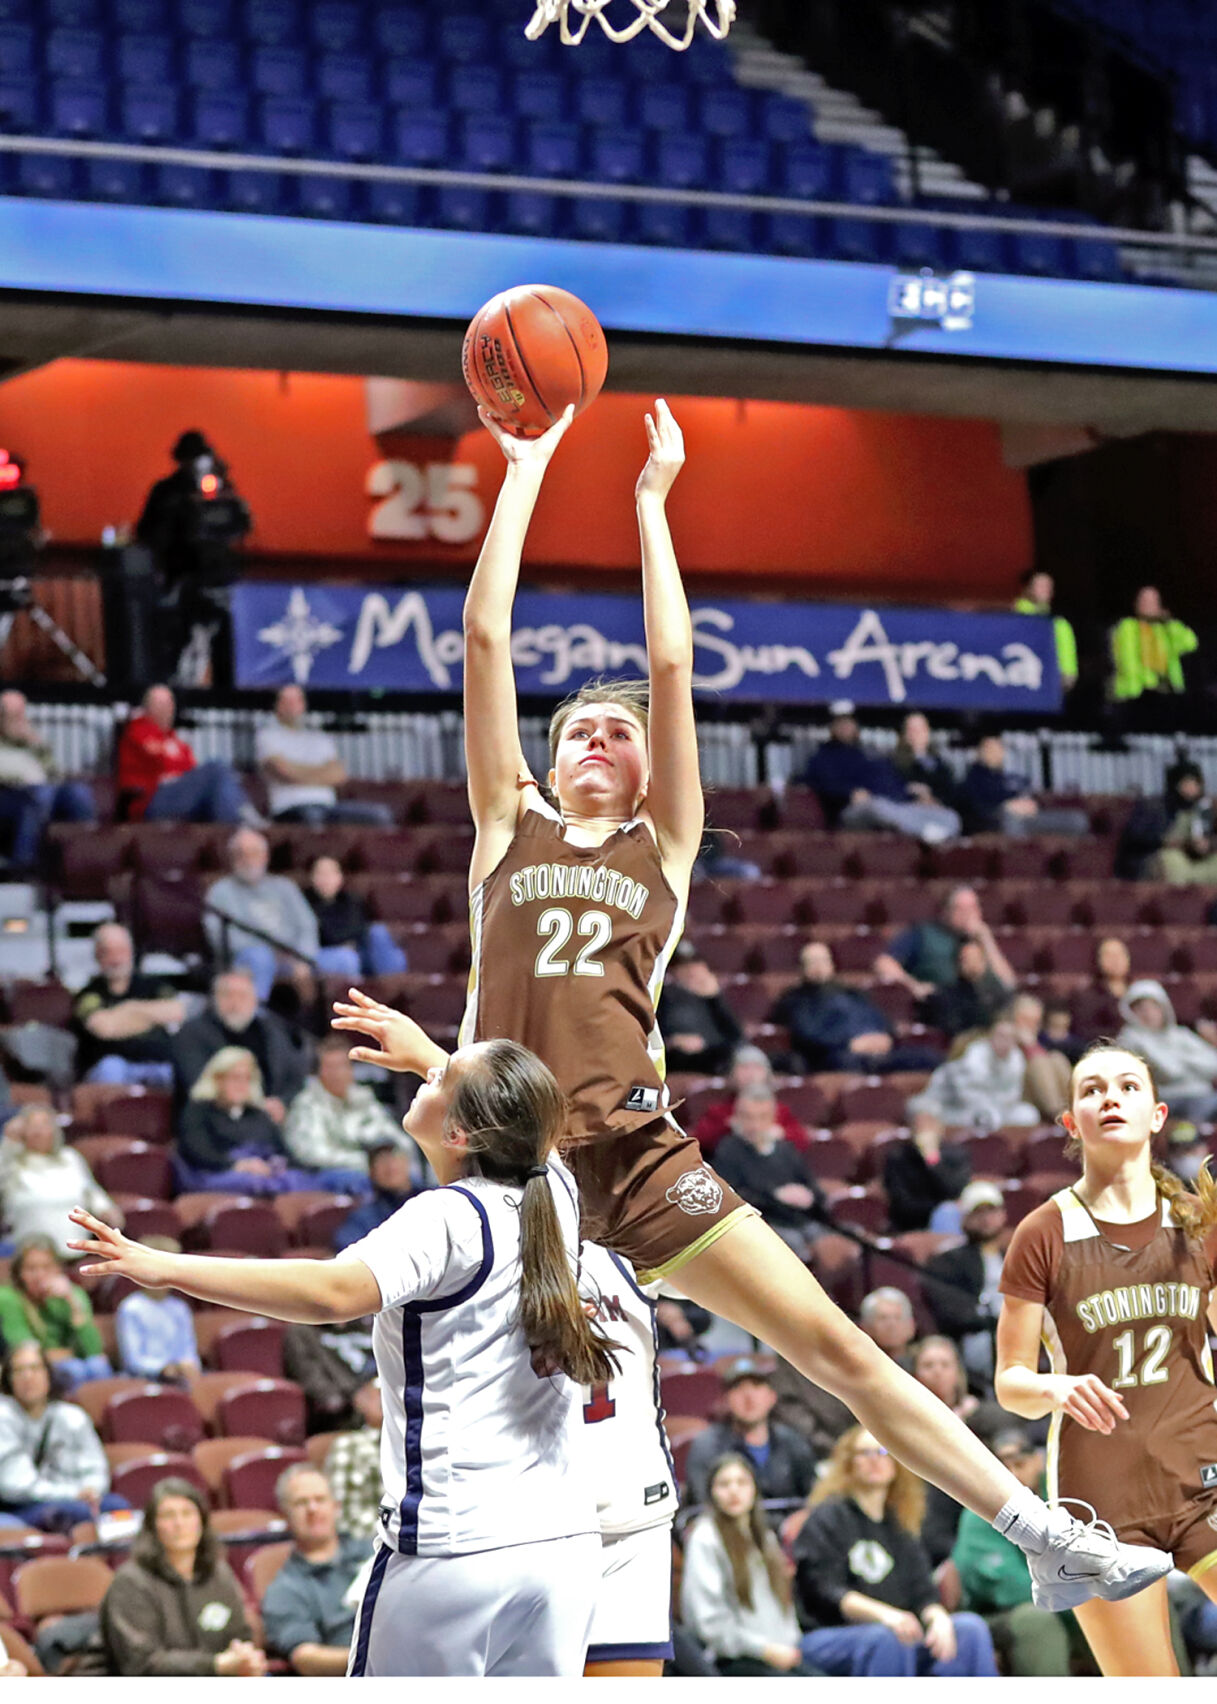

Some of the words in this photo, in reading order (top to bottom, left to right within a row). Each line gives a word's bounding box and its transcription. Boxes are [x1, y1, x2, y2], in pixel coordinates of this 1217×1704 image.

[365, 459, 486, 544] 25
[347, 591, 649, 690] Moegan
[691, 607, 820, 691] Sun
[826, 608, 1044, 702] Arena
[509, 863, 650, 920] STONINGTON
[534, 907, 613, 978] 22
[1076, 1282, 1201, 1334] STONINGTON
[1111, 1324, 1174, 1390] 12
